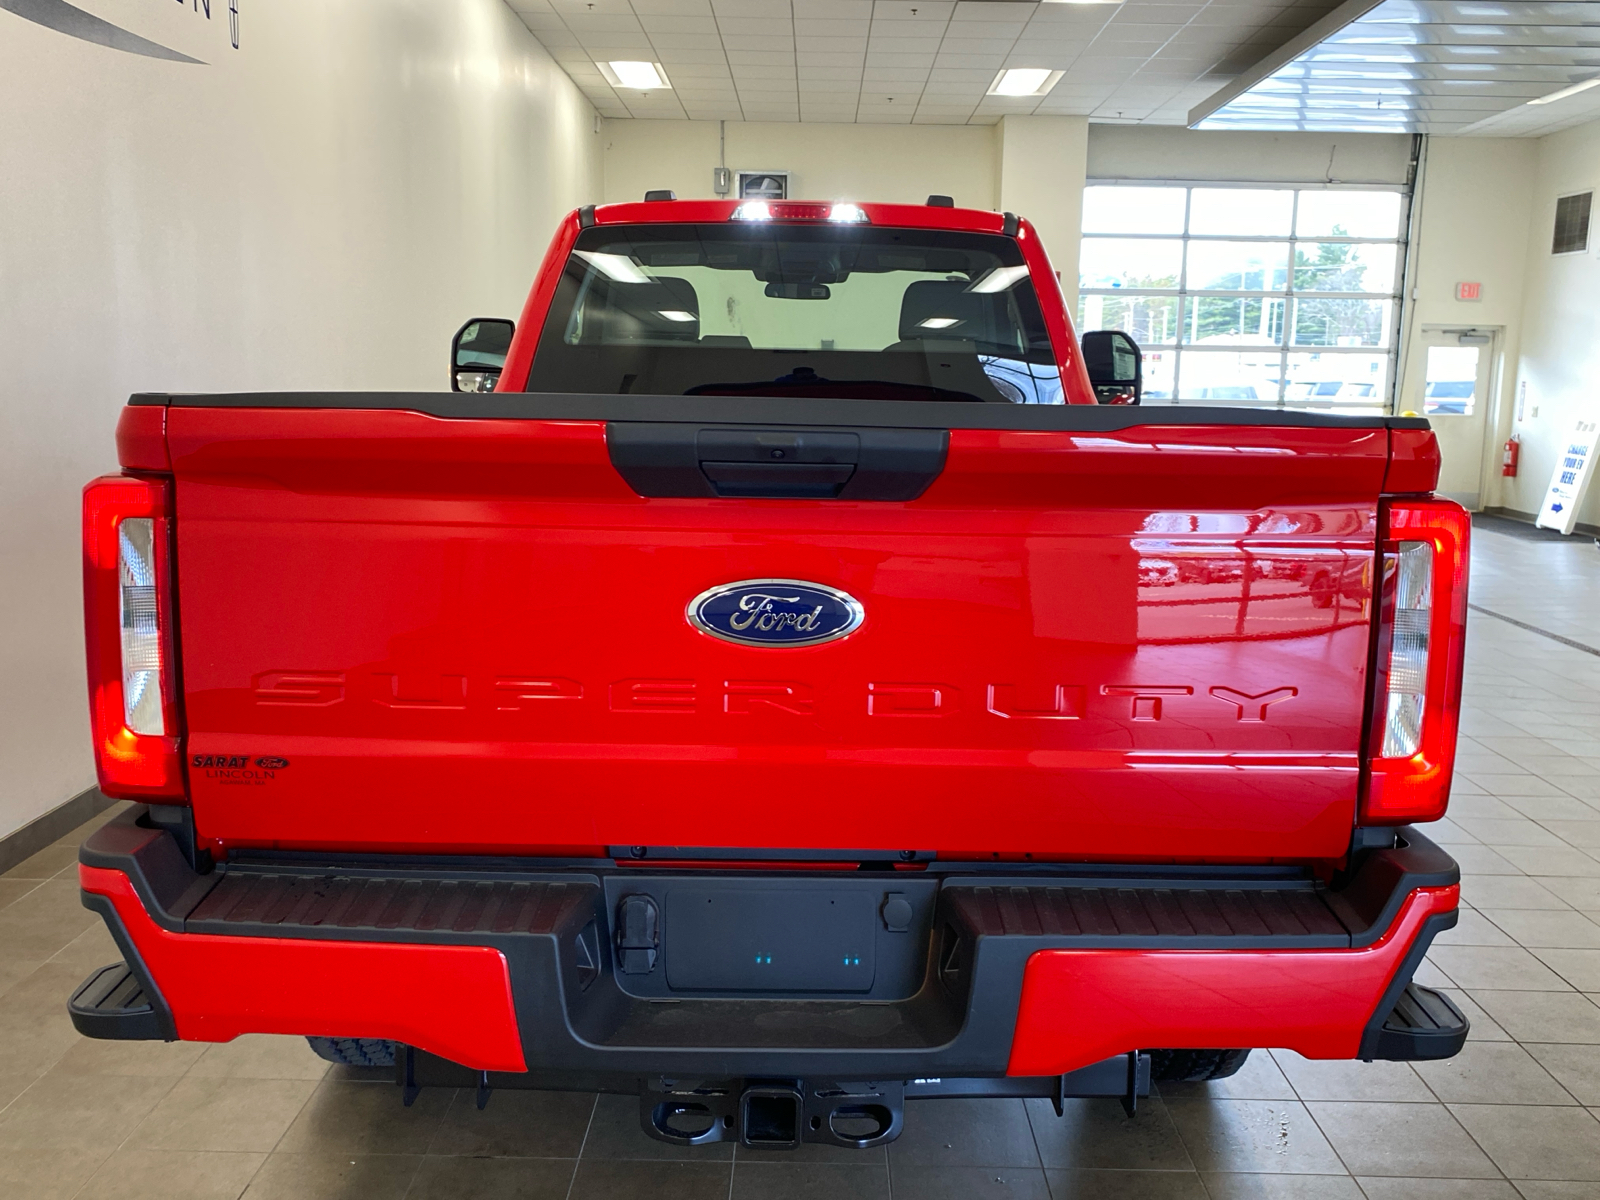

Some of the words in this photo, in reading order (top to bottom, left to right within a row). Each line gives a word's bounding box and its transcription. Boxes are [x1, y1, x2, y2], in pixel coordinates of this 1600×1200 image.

[1461, 282, 1482, 299] EXIT
[1567, 444, 1588, 456] CHARGE
[1563, 457, 1578, 468] YOUR
[1576, 459, 1584, 470] EV
[1560, 471, 1576, 485] HERE
[729, 593, 822, 631] Ford
[252, 669, 814, 715] SUPER
[867, 682, 1299, 724] DUTY
[193, 755, 249, 768] SARAT
[206, 770, 276, 779] LINCOLN
